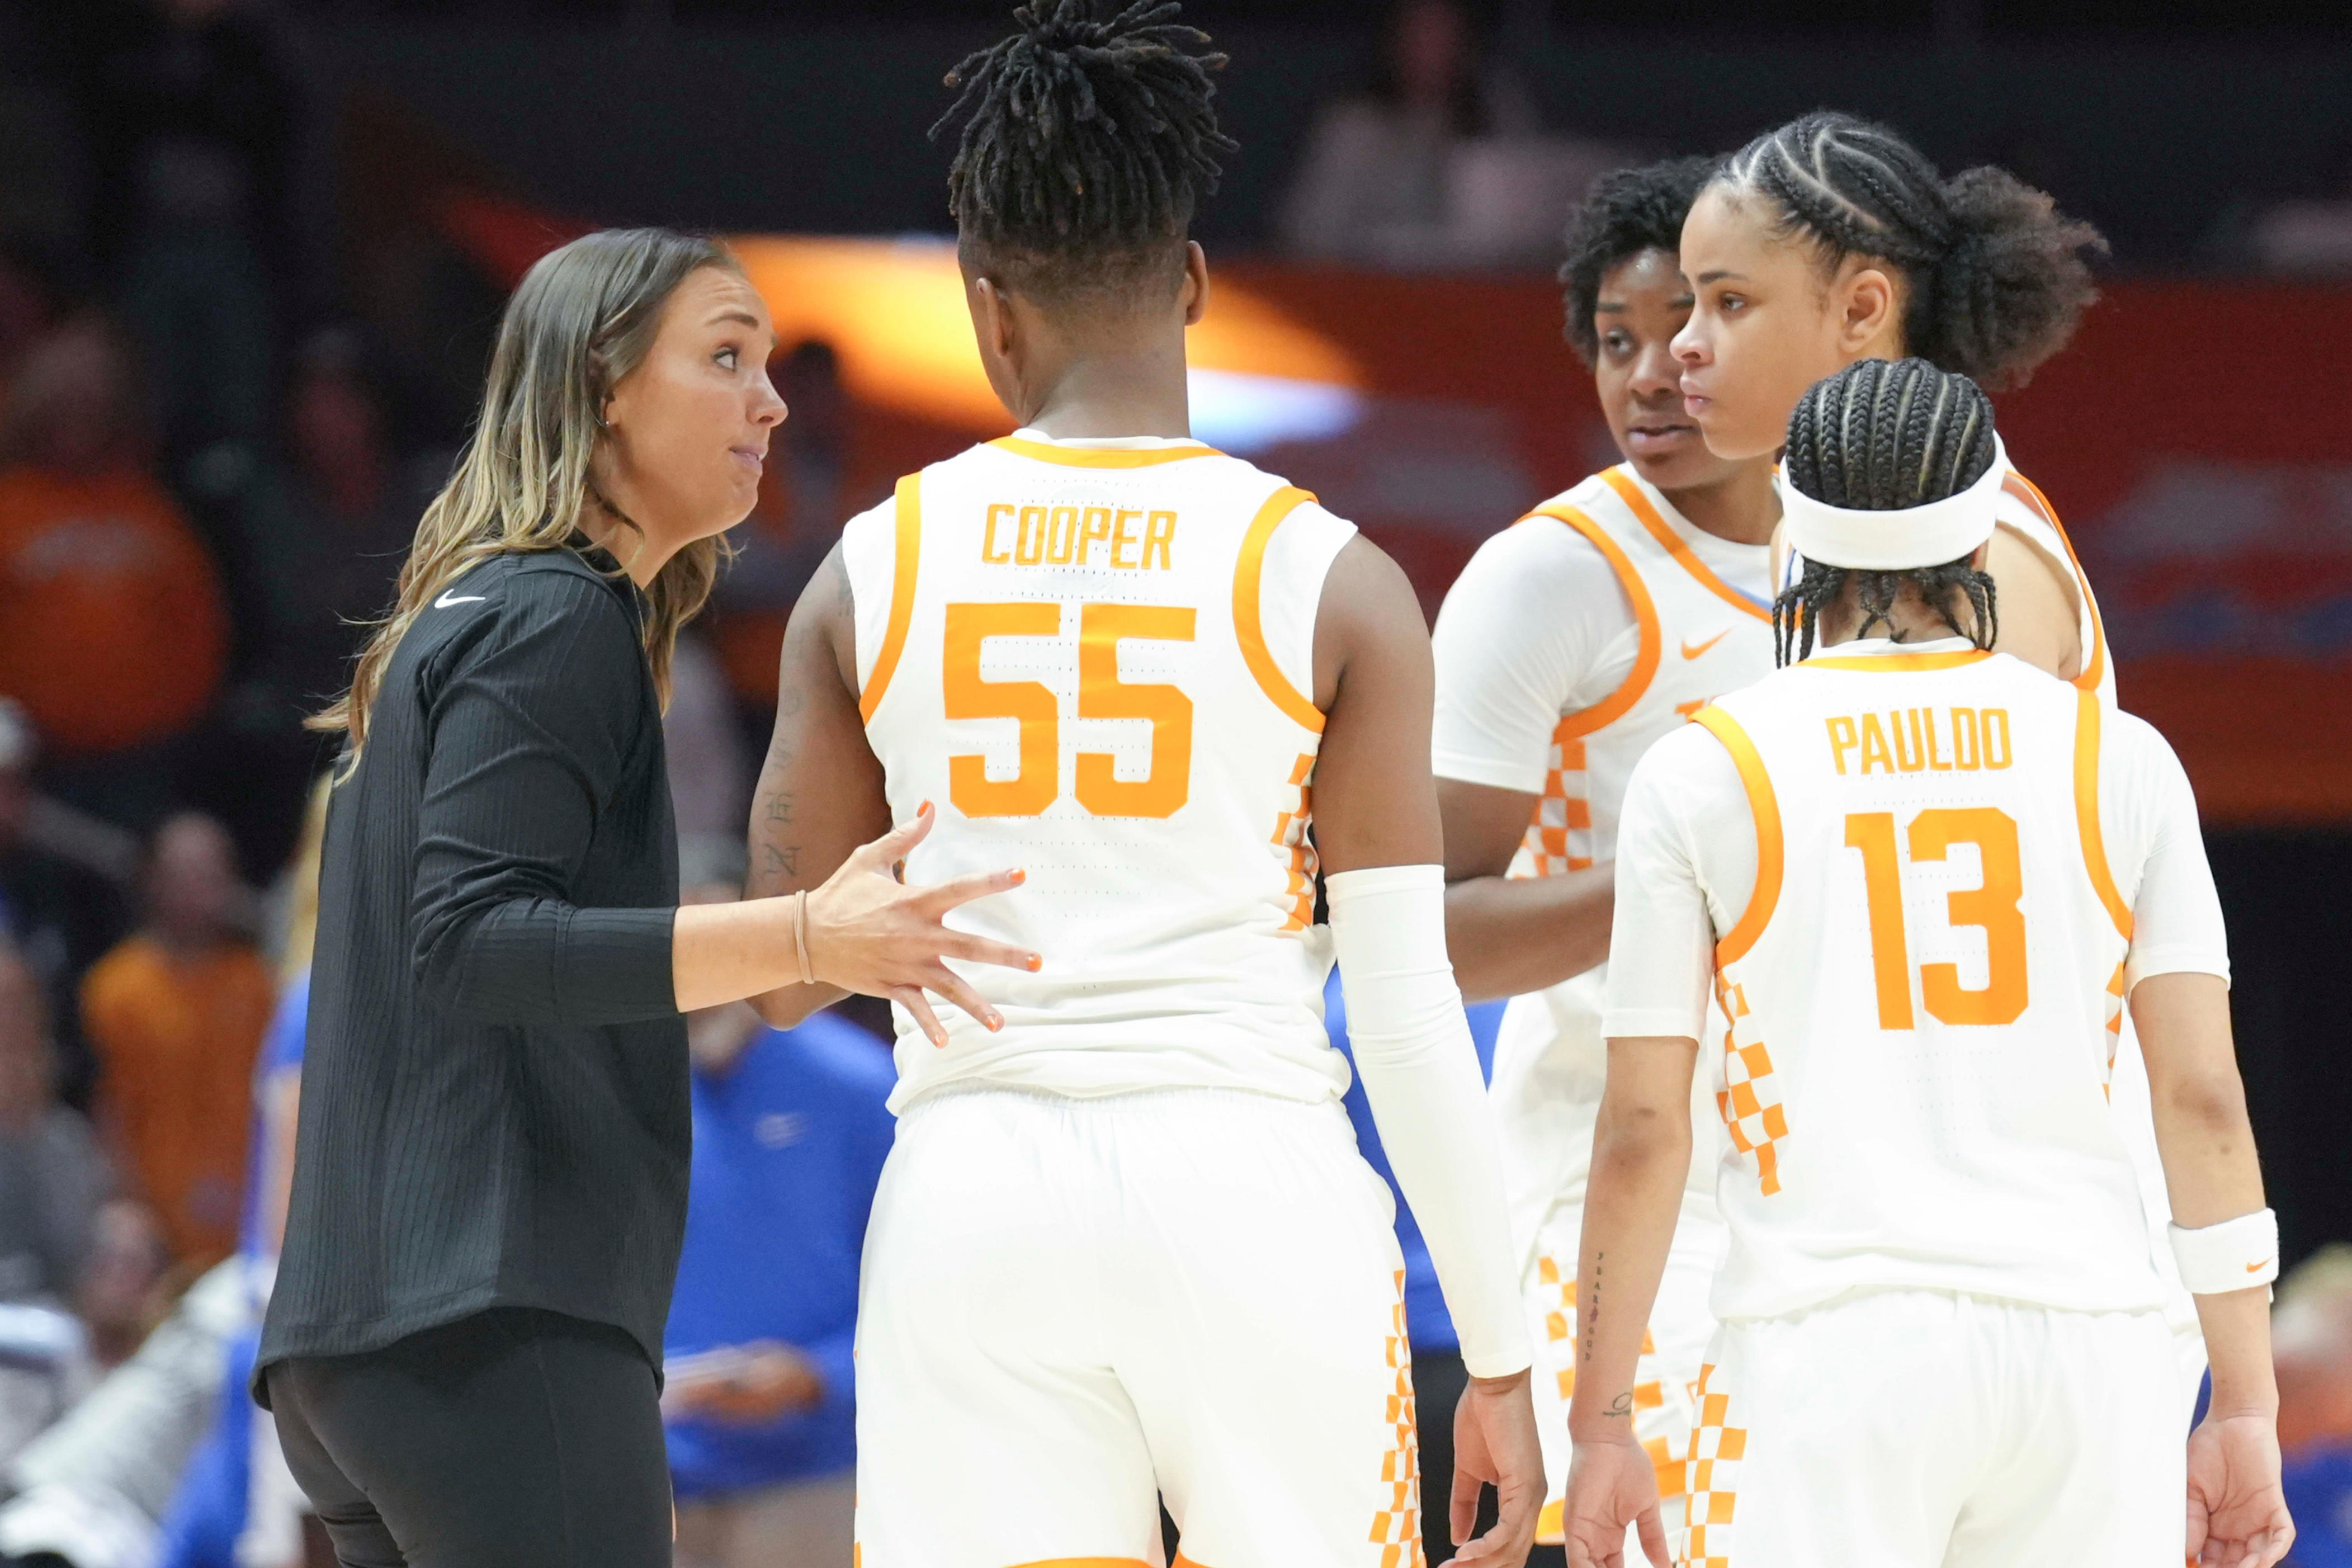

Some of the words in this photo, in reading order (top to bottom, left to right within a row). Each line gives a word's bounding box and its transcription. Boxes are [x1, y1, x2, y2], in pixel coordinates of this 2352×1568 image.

[981, 504, 1178, 570] COOPER
[943, 602, 1197, 819] 55
[1826, 707, 2013, 775] PAULDO
[1844, 807, 2029, 1030] 13
